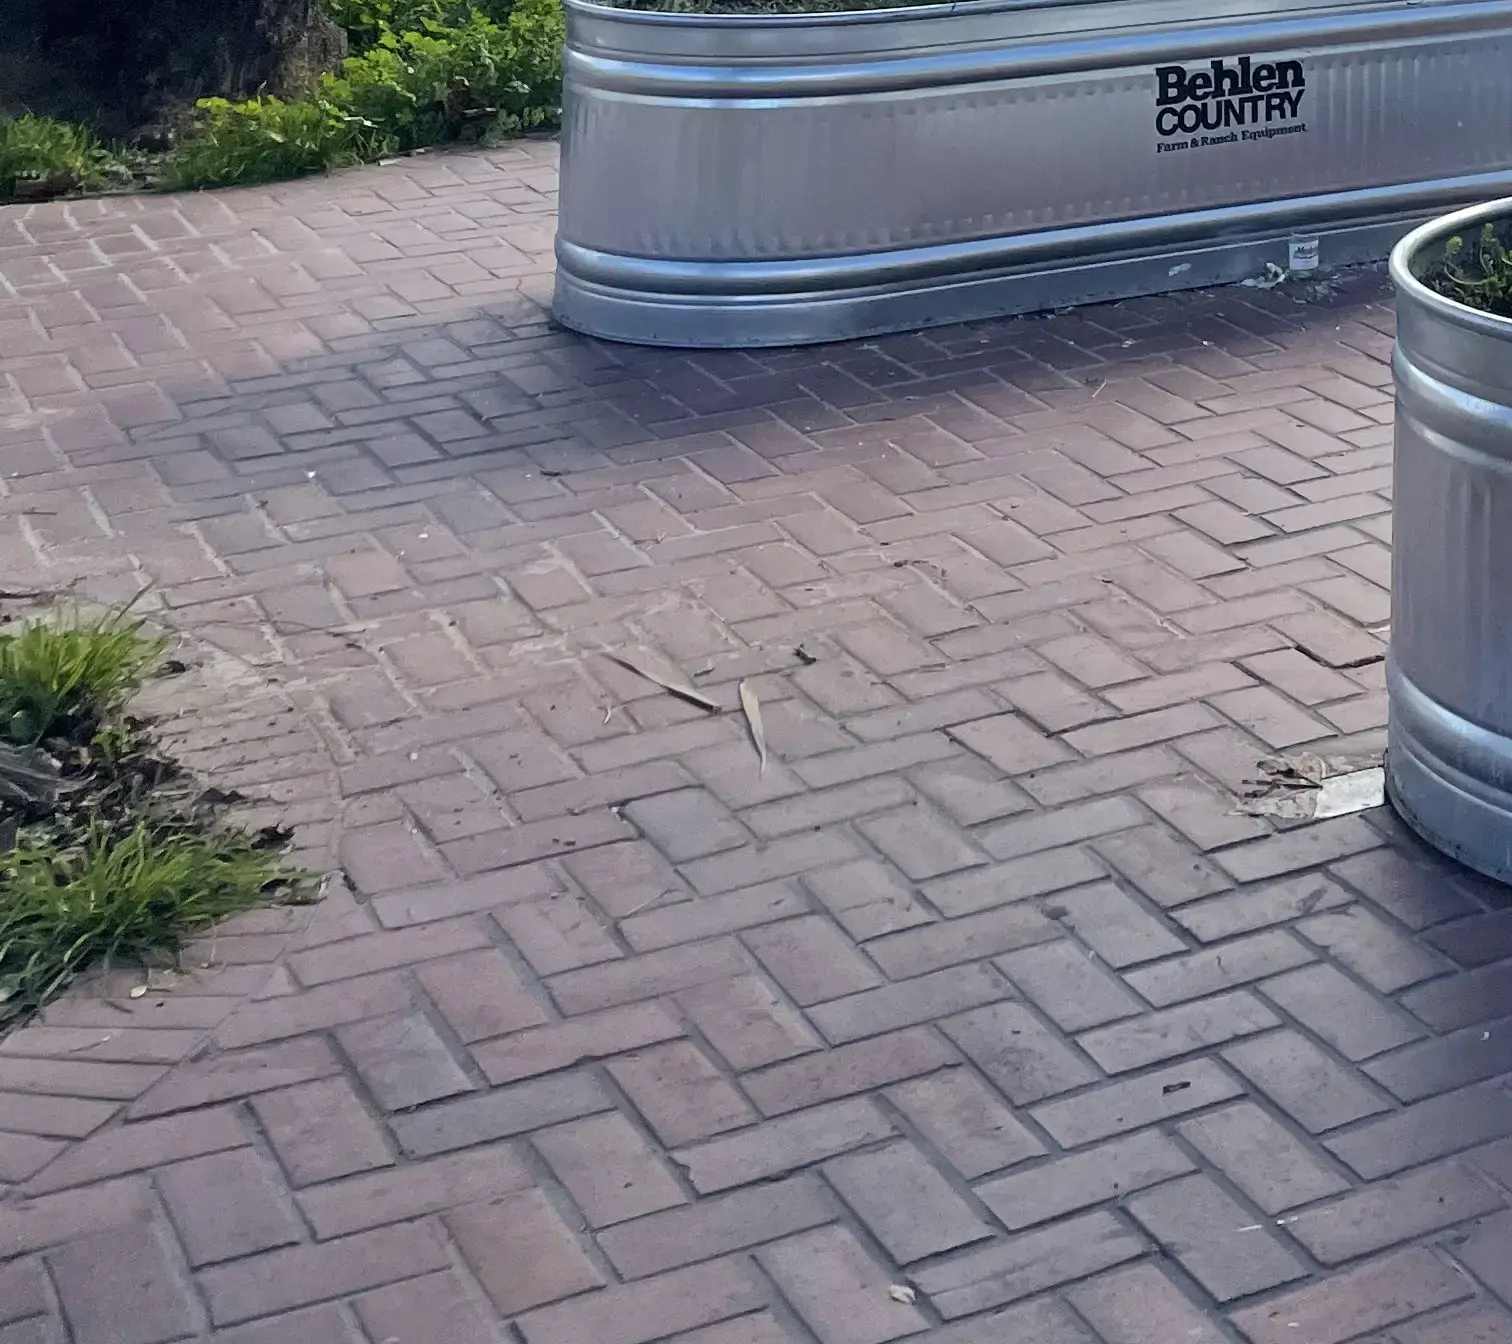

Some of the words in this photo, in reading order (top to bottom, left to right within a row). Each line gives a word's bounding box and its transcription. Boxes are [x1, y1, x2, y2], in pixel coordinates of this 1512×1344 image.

[1155, 56, 1306, 107] Behlen
[1156, 89, 1306, 136] COUNTRY
[1156, 141, 1189, 153] Farm
[1200, 130, 1238, 146] Ranch
[1241, 122, 1308, 141] Equipment
